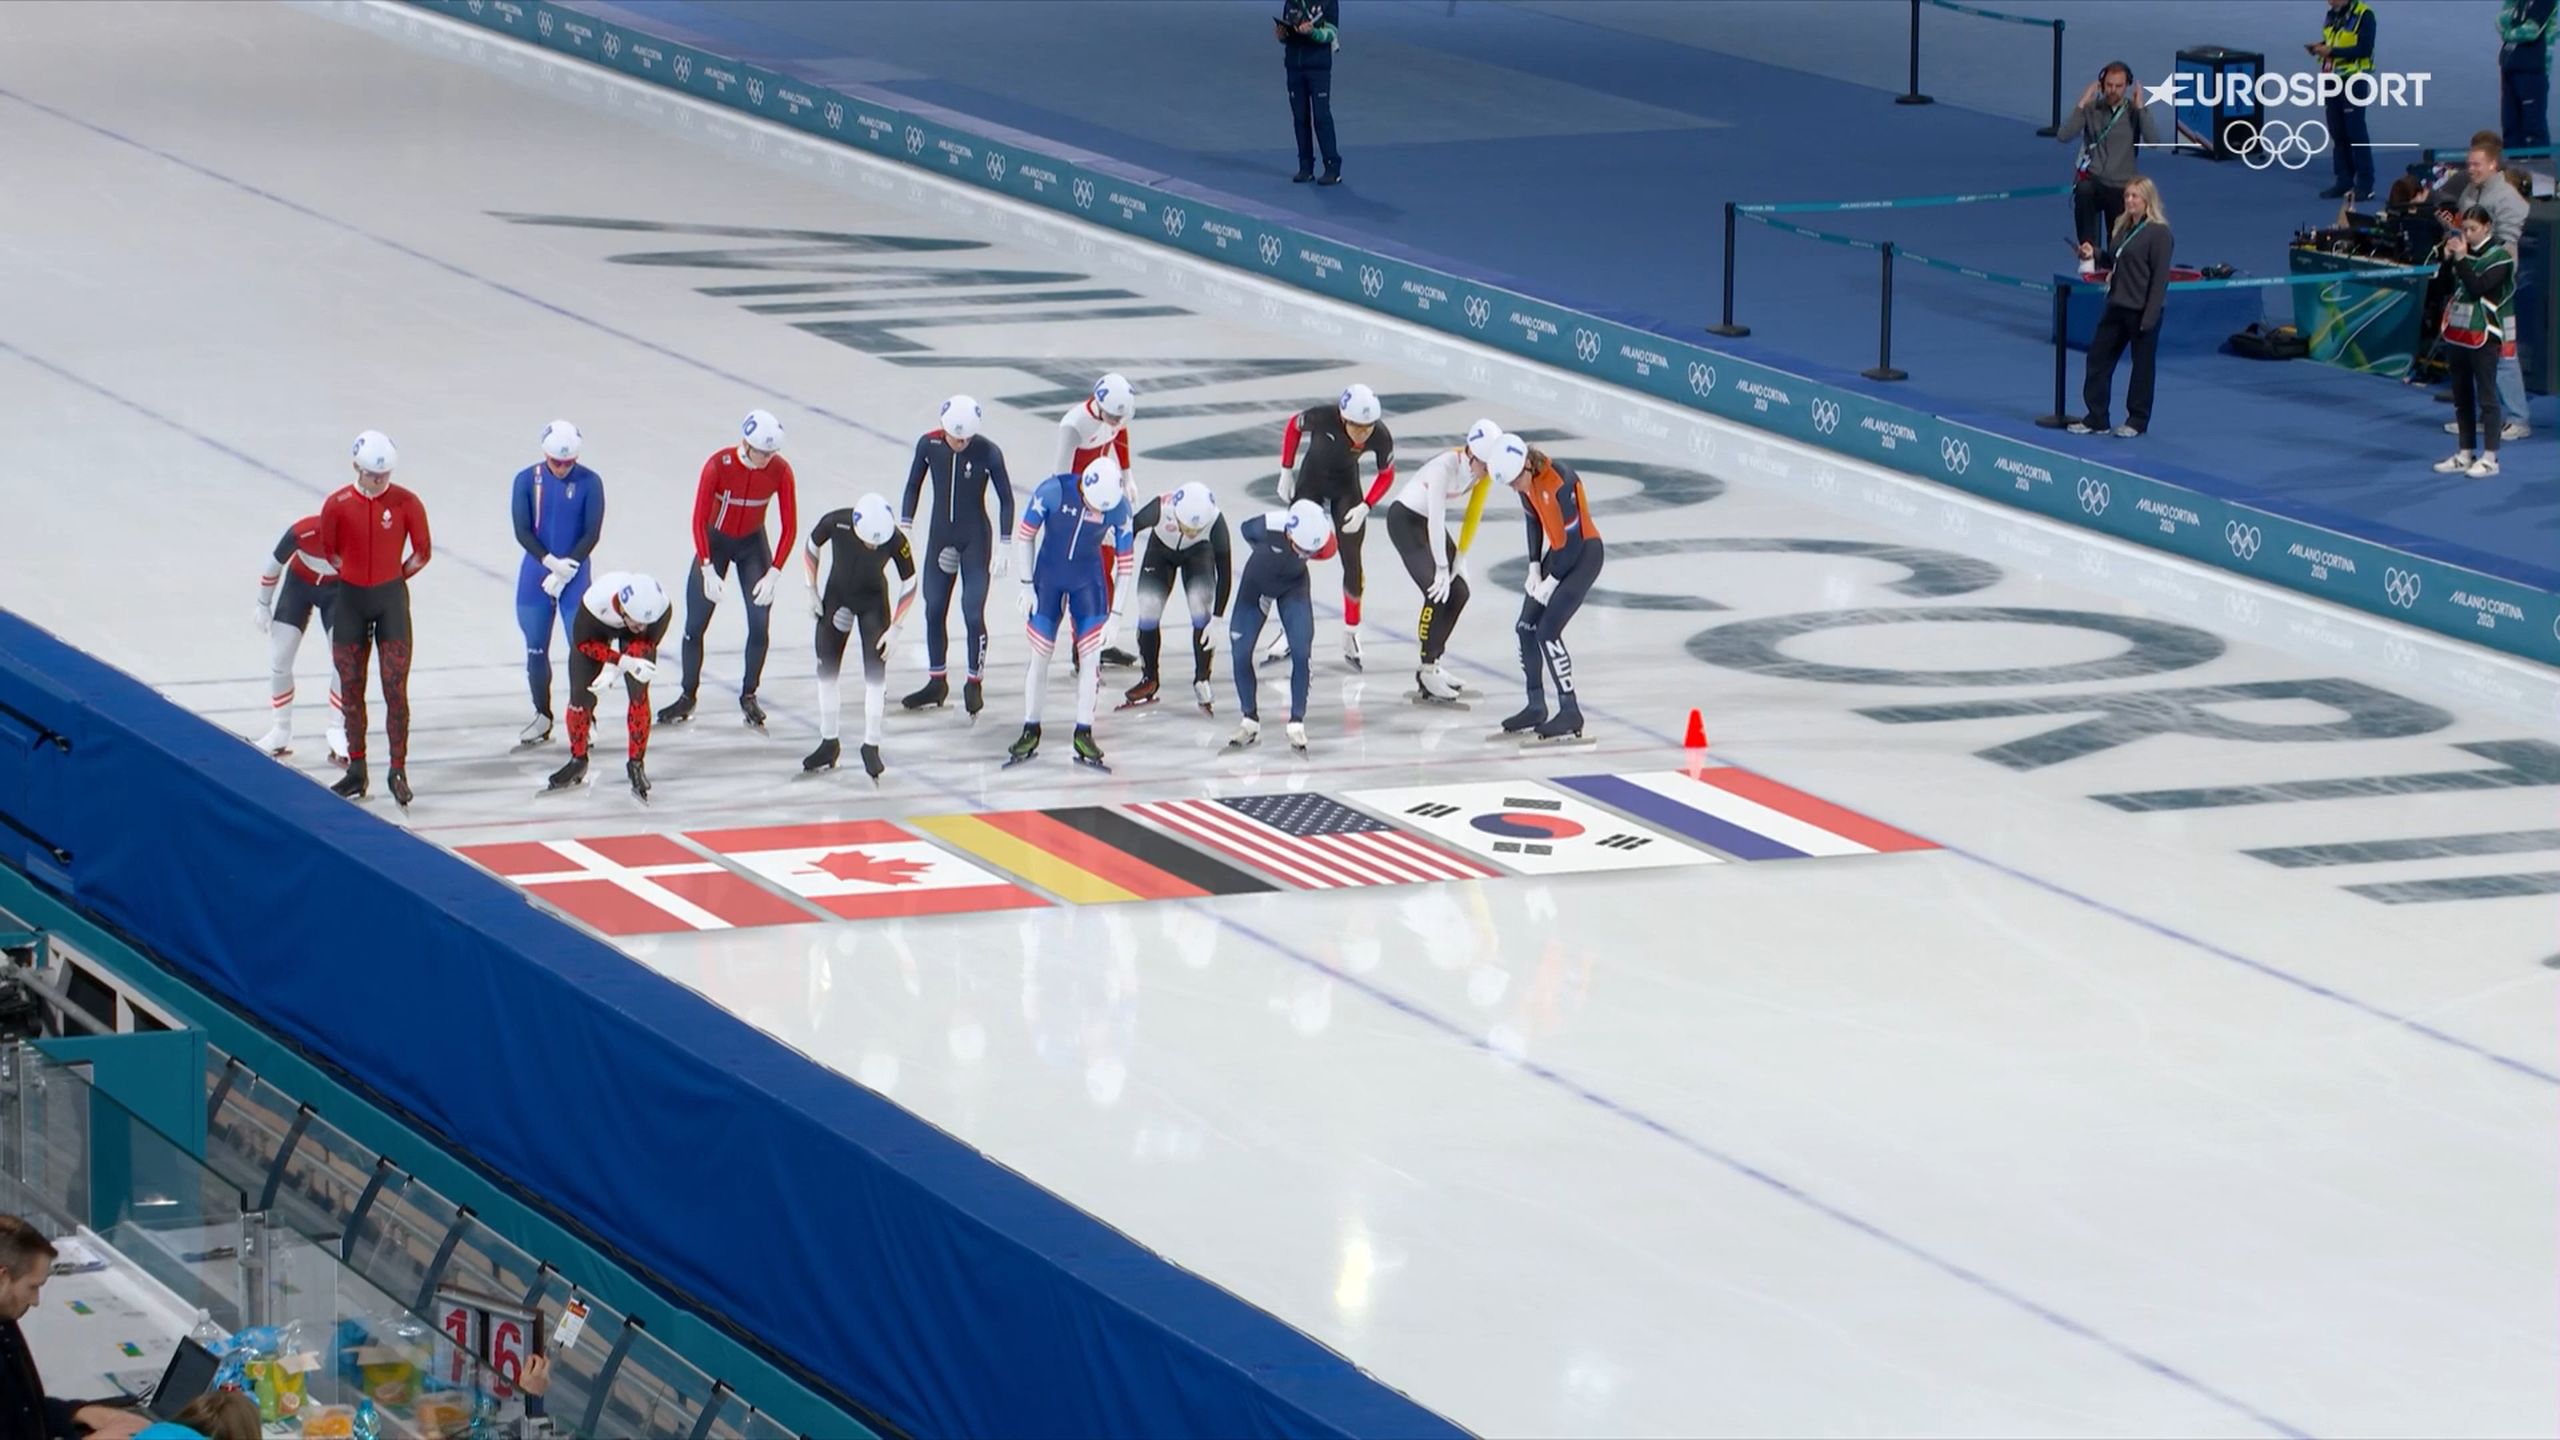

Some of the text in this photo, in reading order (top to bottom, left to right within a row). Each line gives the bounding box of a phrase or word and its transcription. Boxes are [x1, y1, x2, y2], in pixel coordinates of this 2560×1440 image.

[1620, 345, 1669, 369] MILANO CORTINA
[1735, 378, 1790, 406] MILANO CORTINA
[1860, 416, 1918, 443] MILANO CORTINA
[1085, 473, 1099, 487] 3
[1994, 456, 2053, 485] MILANO CORTINA
[2015, 475, 2030, 492] 2026
[2135, 498, 2200, 527] MILANO CORTINA
[2159, 518, 2175, 534] 2026
[2287, 543, 2356, 574] MILANO CORTINA
[2311, 564, 2328, 581] 2026
[620, 585, 634, 604] 5
[2449, 590, 2525, 621] MILANO CORTINA
[1420, 607, 1433, 656] BE
[1518, 621, 1537, 631] FILA
[2476, 611, 2495, 629] 2026
[1545, 639, 1574, 693] NED
